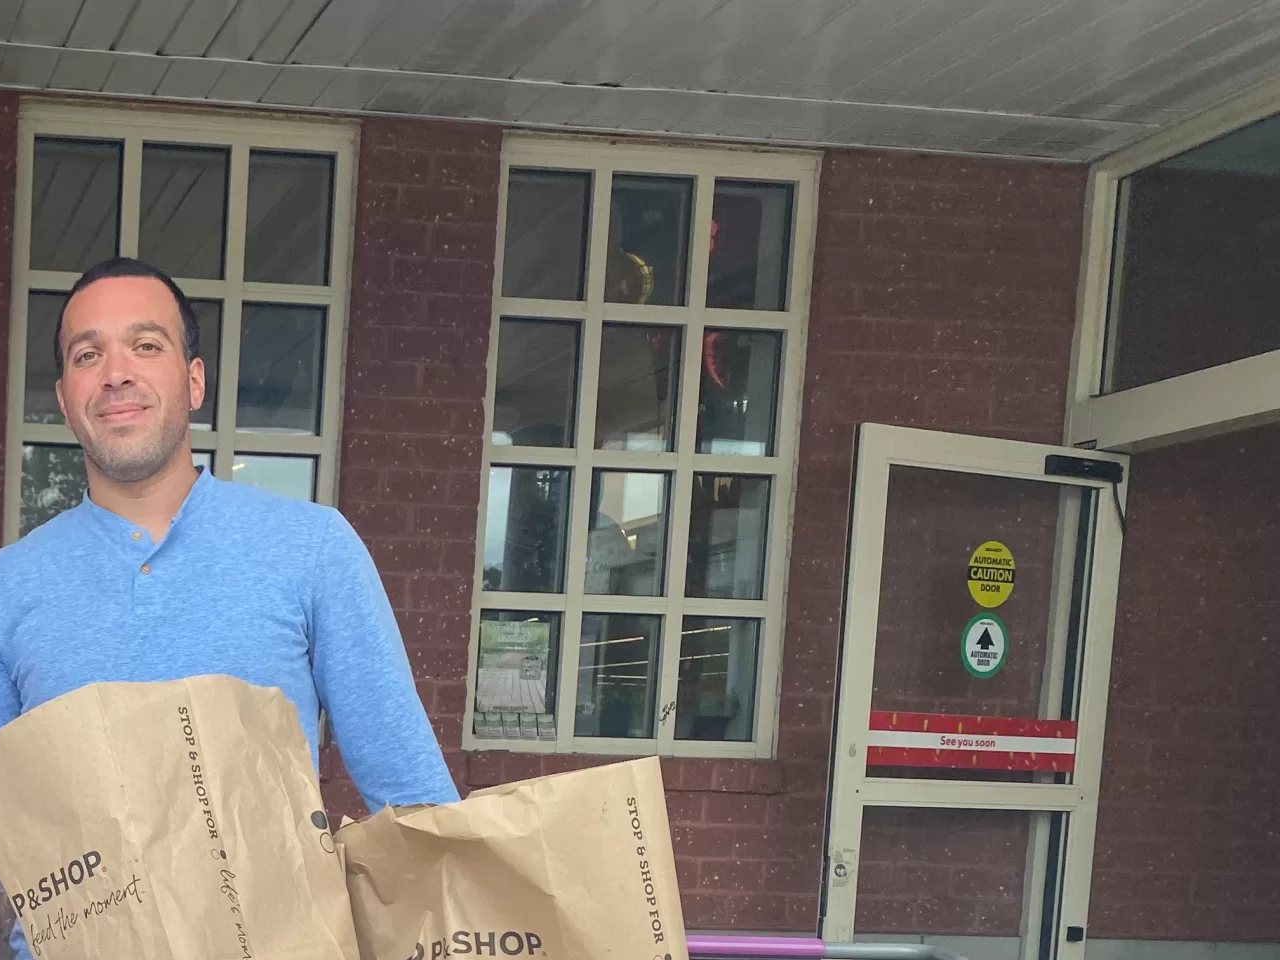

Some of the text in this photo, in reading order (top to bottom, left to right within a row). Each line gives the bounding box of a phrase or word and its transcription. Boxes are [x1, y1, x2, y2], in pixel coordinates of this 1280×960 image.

[974, 556, 1012, 566] AUTOMATIC
[970, 568, 1012, 581] CAUTION
[980, 584, 1000, 592] DOOR
[970, 650, 998, 660] AUTOMATIC
[940, 736, 956, 745] See
[957, 739, 974, 748] you
[177, 706, 218, 839] STOP & SHOP FOR
[627, 796, 664, 944] STOP & SHOP FOR
[30, 874, 142, 956] feed the moment
